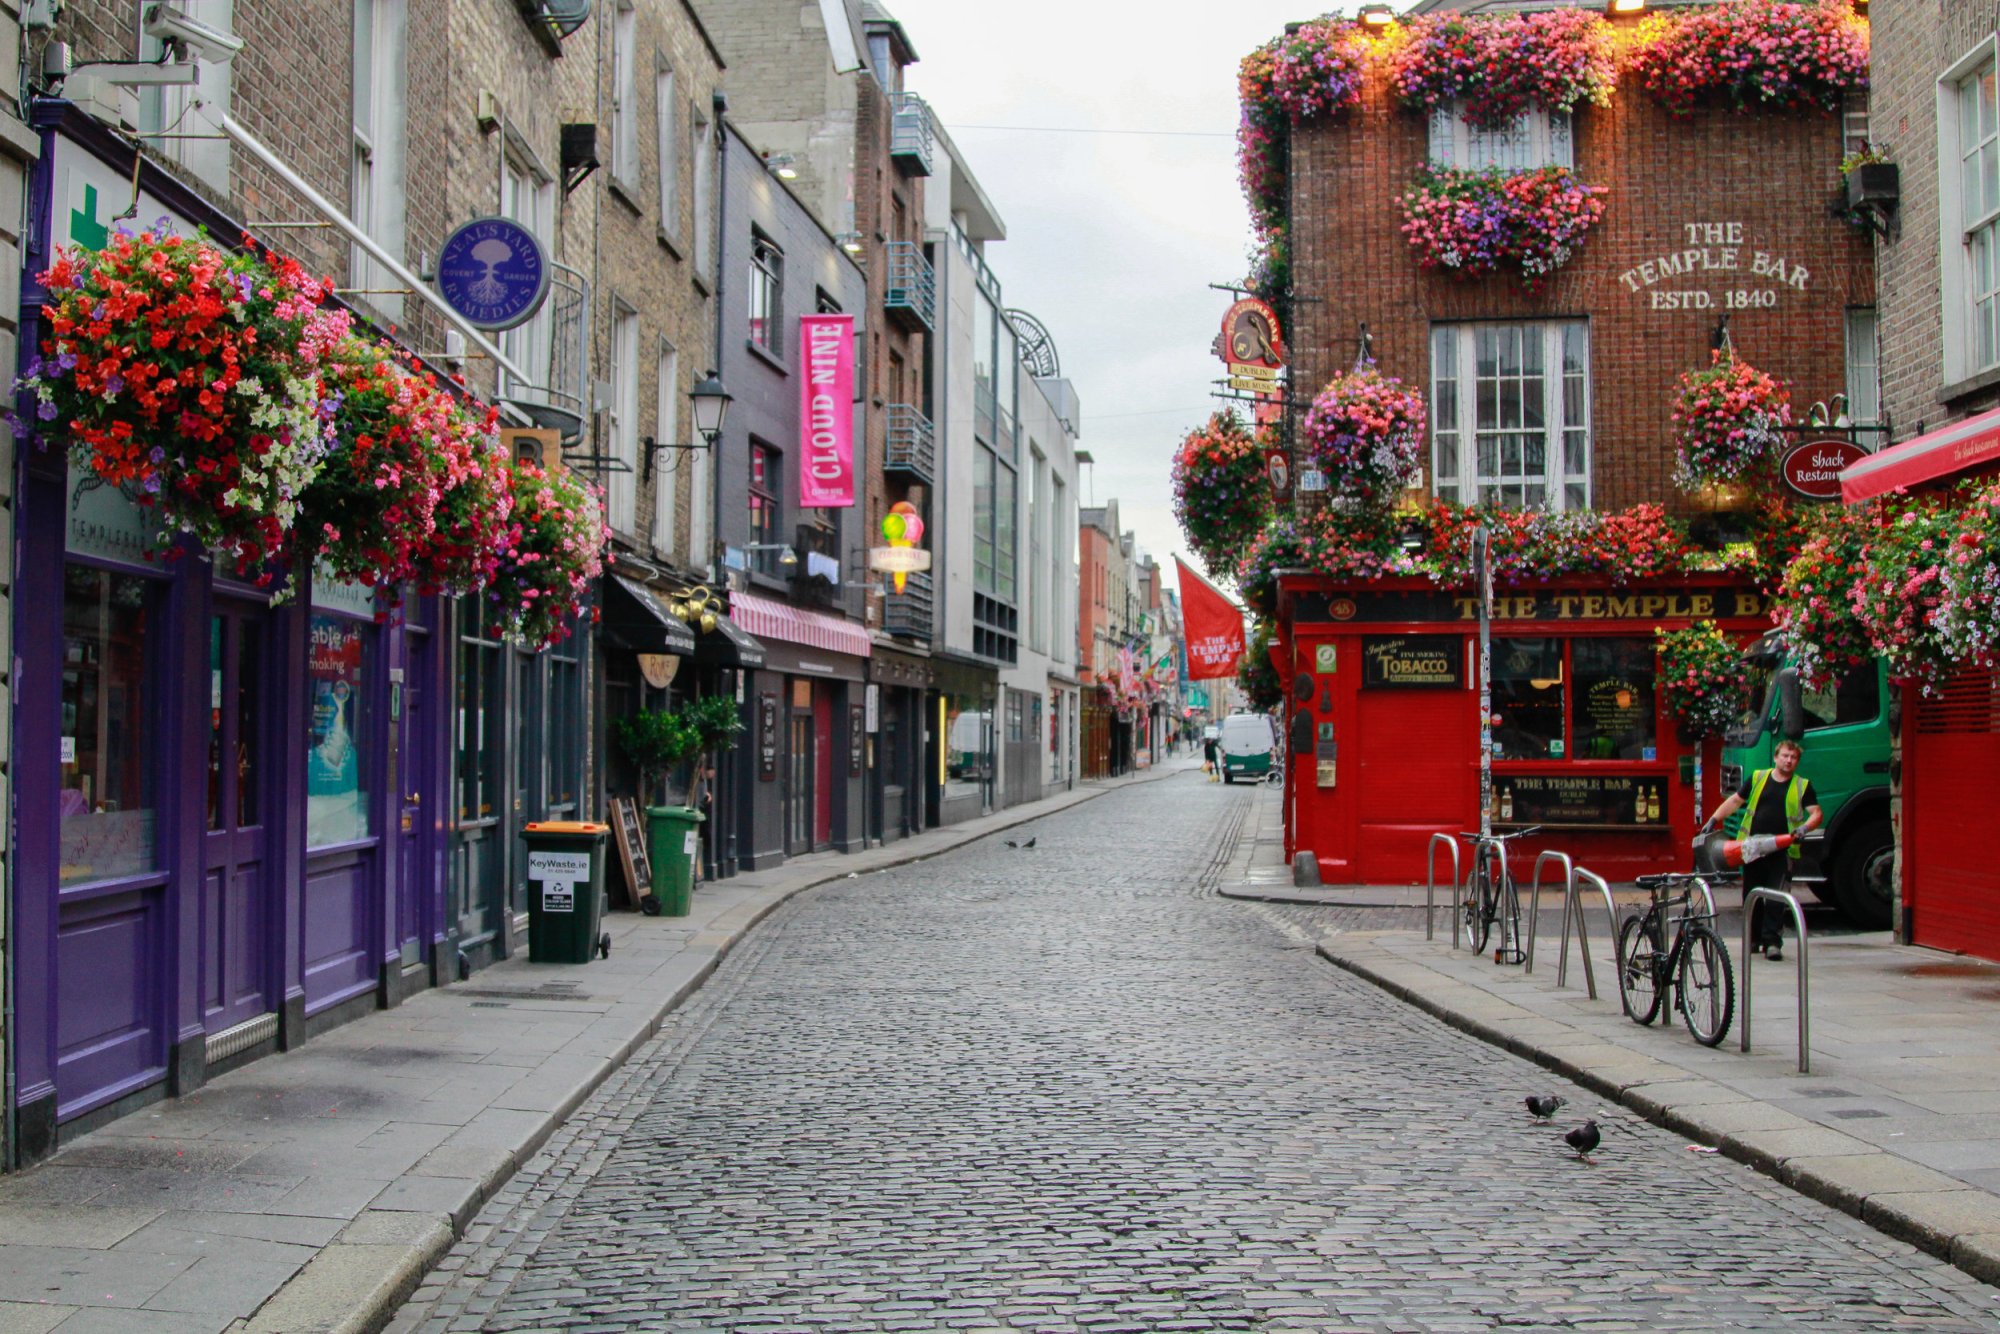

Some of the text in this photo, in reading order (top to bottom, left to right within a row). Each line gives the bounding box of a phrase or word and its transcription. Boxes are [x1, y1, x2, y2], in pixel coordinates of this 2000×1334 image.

[1684, 222, 1743, 244] THE
[446, 224, 537, 269] NEAL'S YARD
[443, 269, 474, 277] COVENT
[1618, 247, 1809, 293] TEMPLE BAR
[446, 283, 531, 319] REMEDIES
[1651, 289, 1776, 310] ESTD. 1840
[1235, 302, 1269, 319] TEMPLE
[1269, 318, 1279, 342] BAR
[811, 323, 843, 385] NINE
[1240, 365, 1267, 376] DUBLIN
[1235, 380, 1273, 390] LIVE MUSIC
[811, 394, 842, 480] CLOUD
[1812, 449, 1845, 469] Shack
[1454, 597, 1537, 619] THE
[1552, 595, 1715, 618] TEMPLE
[1191, 641, 1242, 656] TEMPLE
[1204, 636, 1225, 645] THE
[1204, 653, 1231, 664] BAR
[1589, 680, 1639, 694] TEMPLE BAR
[1514, 778, 1632, 790] THE TEMPLE BAR
[529, 859, 587, 869] KeyWaste.ie
